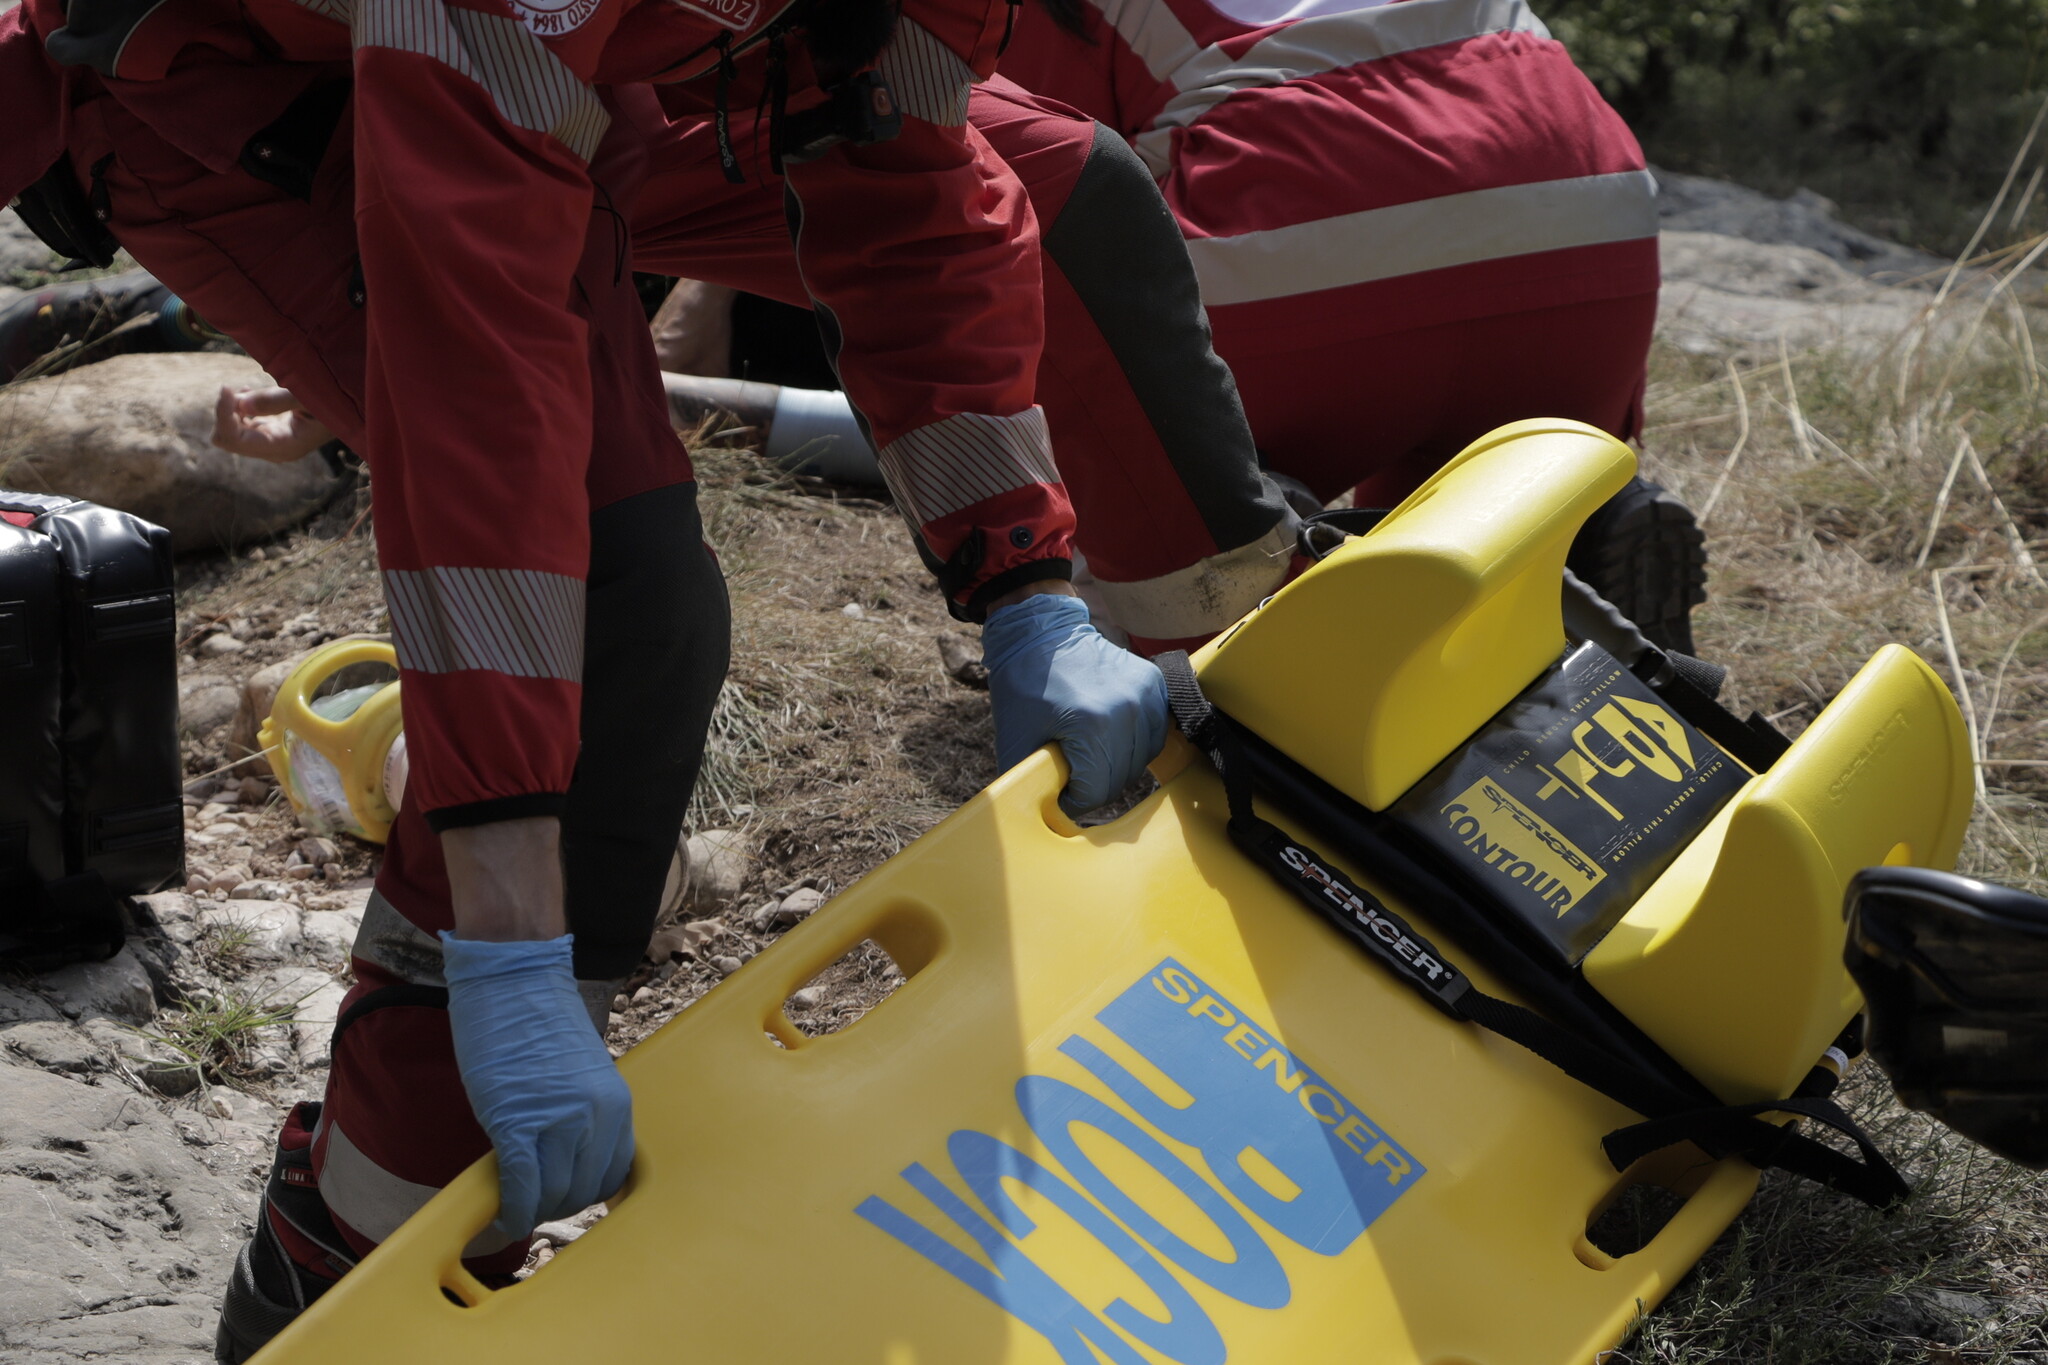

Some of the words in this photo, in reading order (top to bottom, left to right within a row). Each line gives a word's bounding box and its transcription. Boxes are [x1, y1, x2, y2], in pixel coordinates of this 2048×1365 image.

[533, 14, 565, 33] 1864
[1536, 715, 1570, 744] REMOVE
[1570, 697, 1591, 714] THIS
[1591, 669, 1622, 697] PILLOW
[1482, 784, 1597, 882] SPENCER
[1643, 816, 1663, 834] THIS
[1664, 786, 1696, 815] REMOVE
[1441, 803, 1573, 918] CONTOUR
[1612, 834, 1643, 862] PILLOW
[1151, 966, 1412, 1188] SPENCER
[852, 995, 1400, 1365] ROCK
